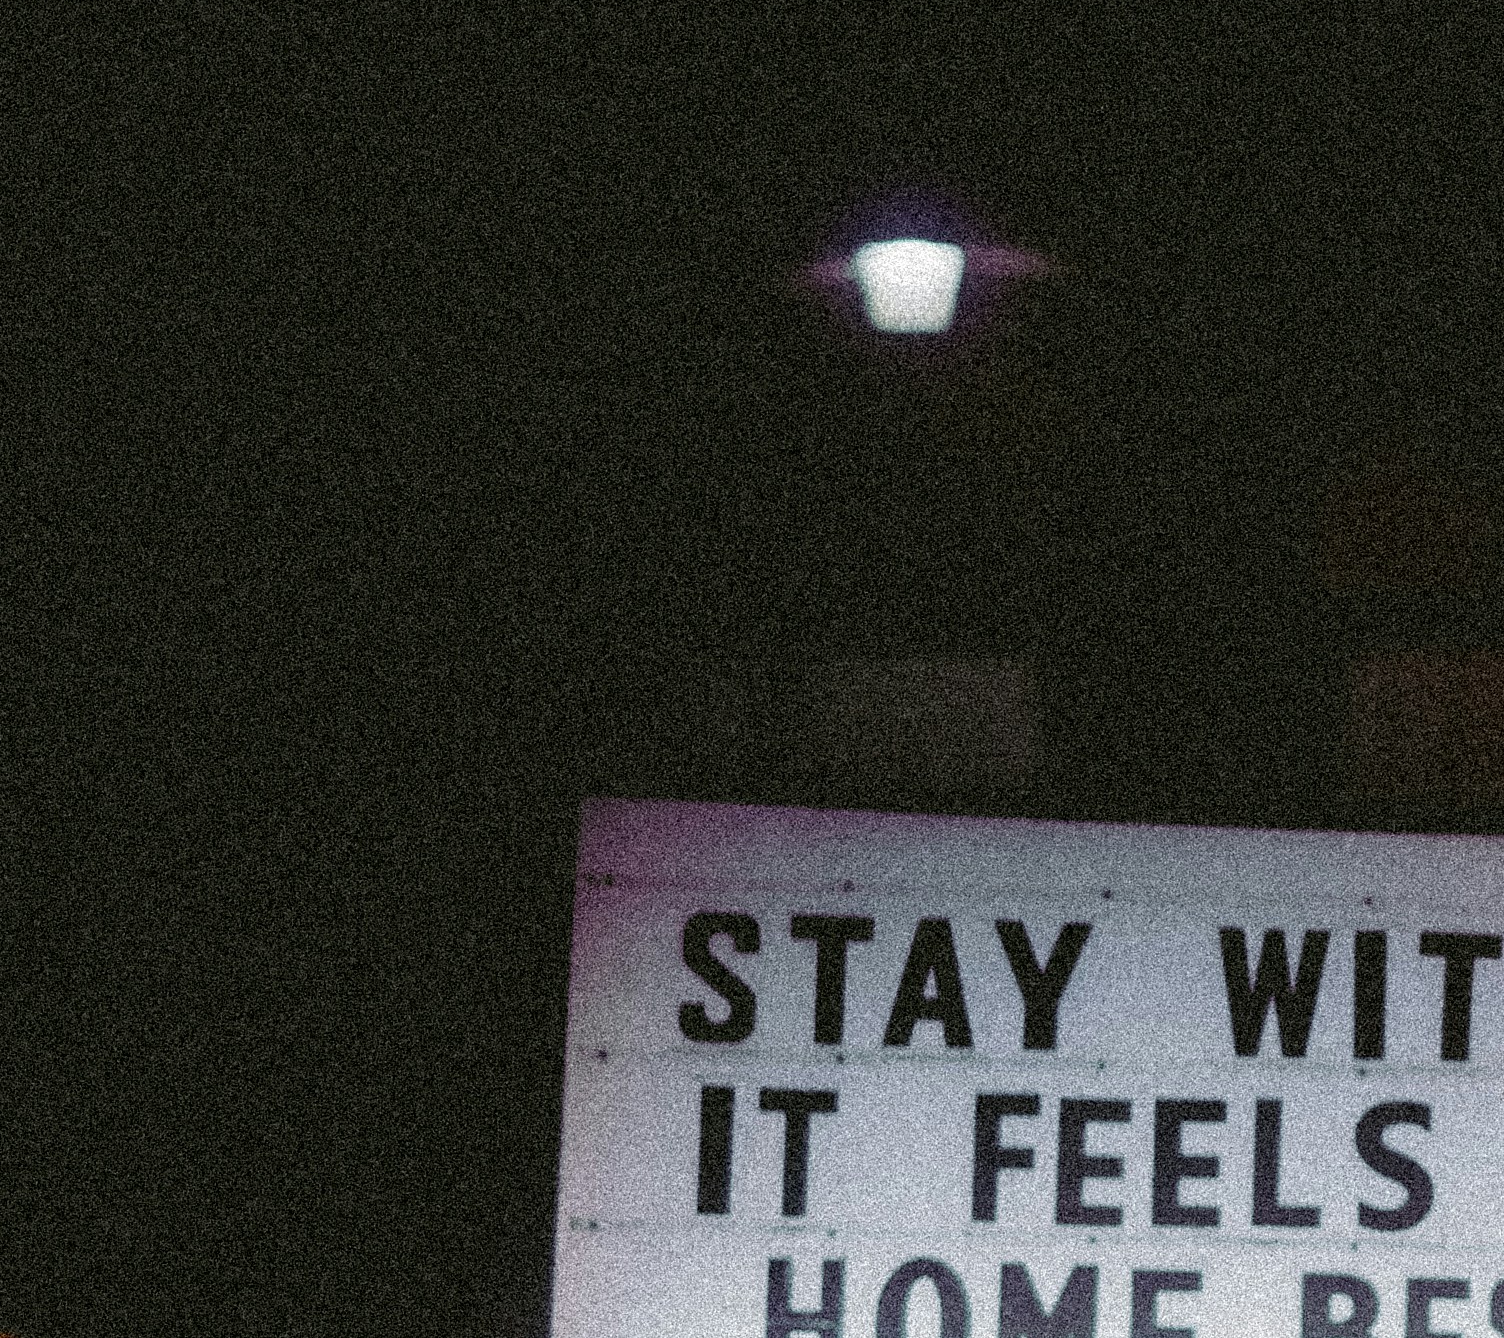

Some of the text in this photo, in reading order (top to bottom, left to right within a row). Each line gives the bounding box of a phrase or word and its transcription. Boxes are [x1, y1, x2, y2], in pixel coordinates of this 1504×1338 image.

[676, 909, 1093, 1053] STAY
[695, 1083, 839, 1219] IT
[969, 1091, 1437, 1233] FEELS
